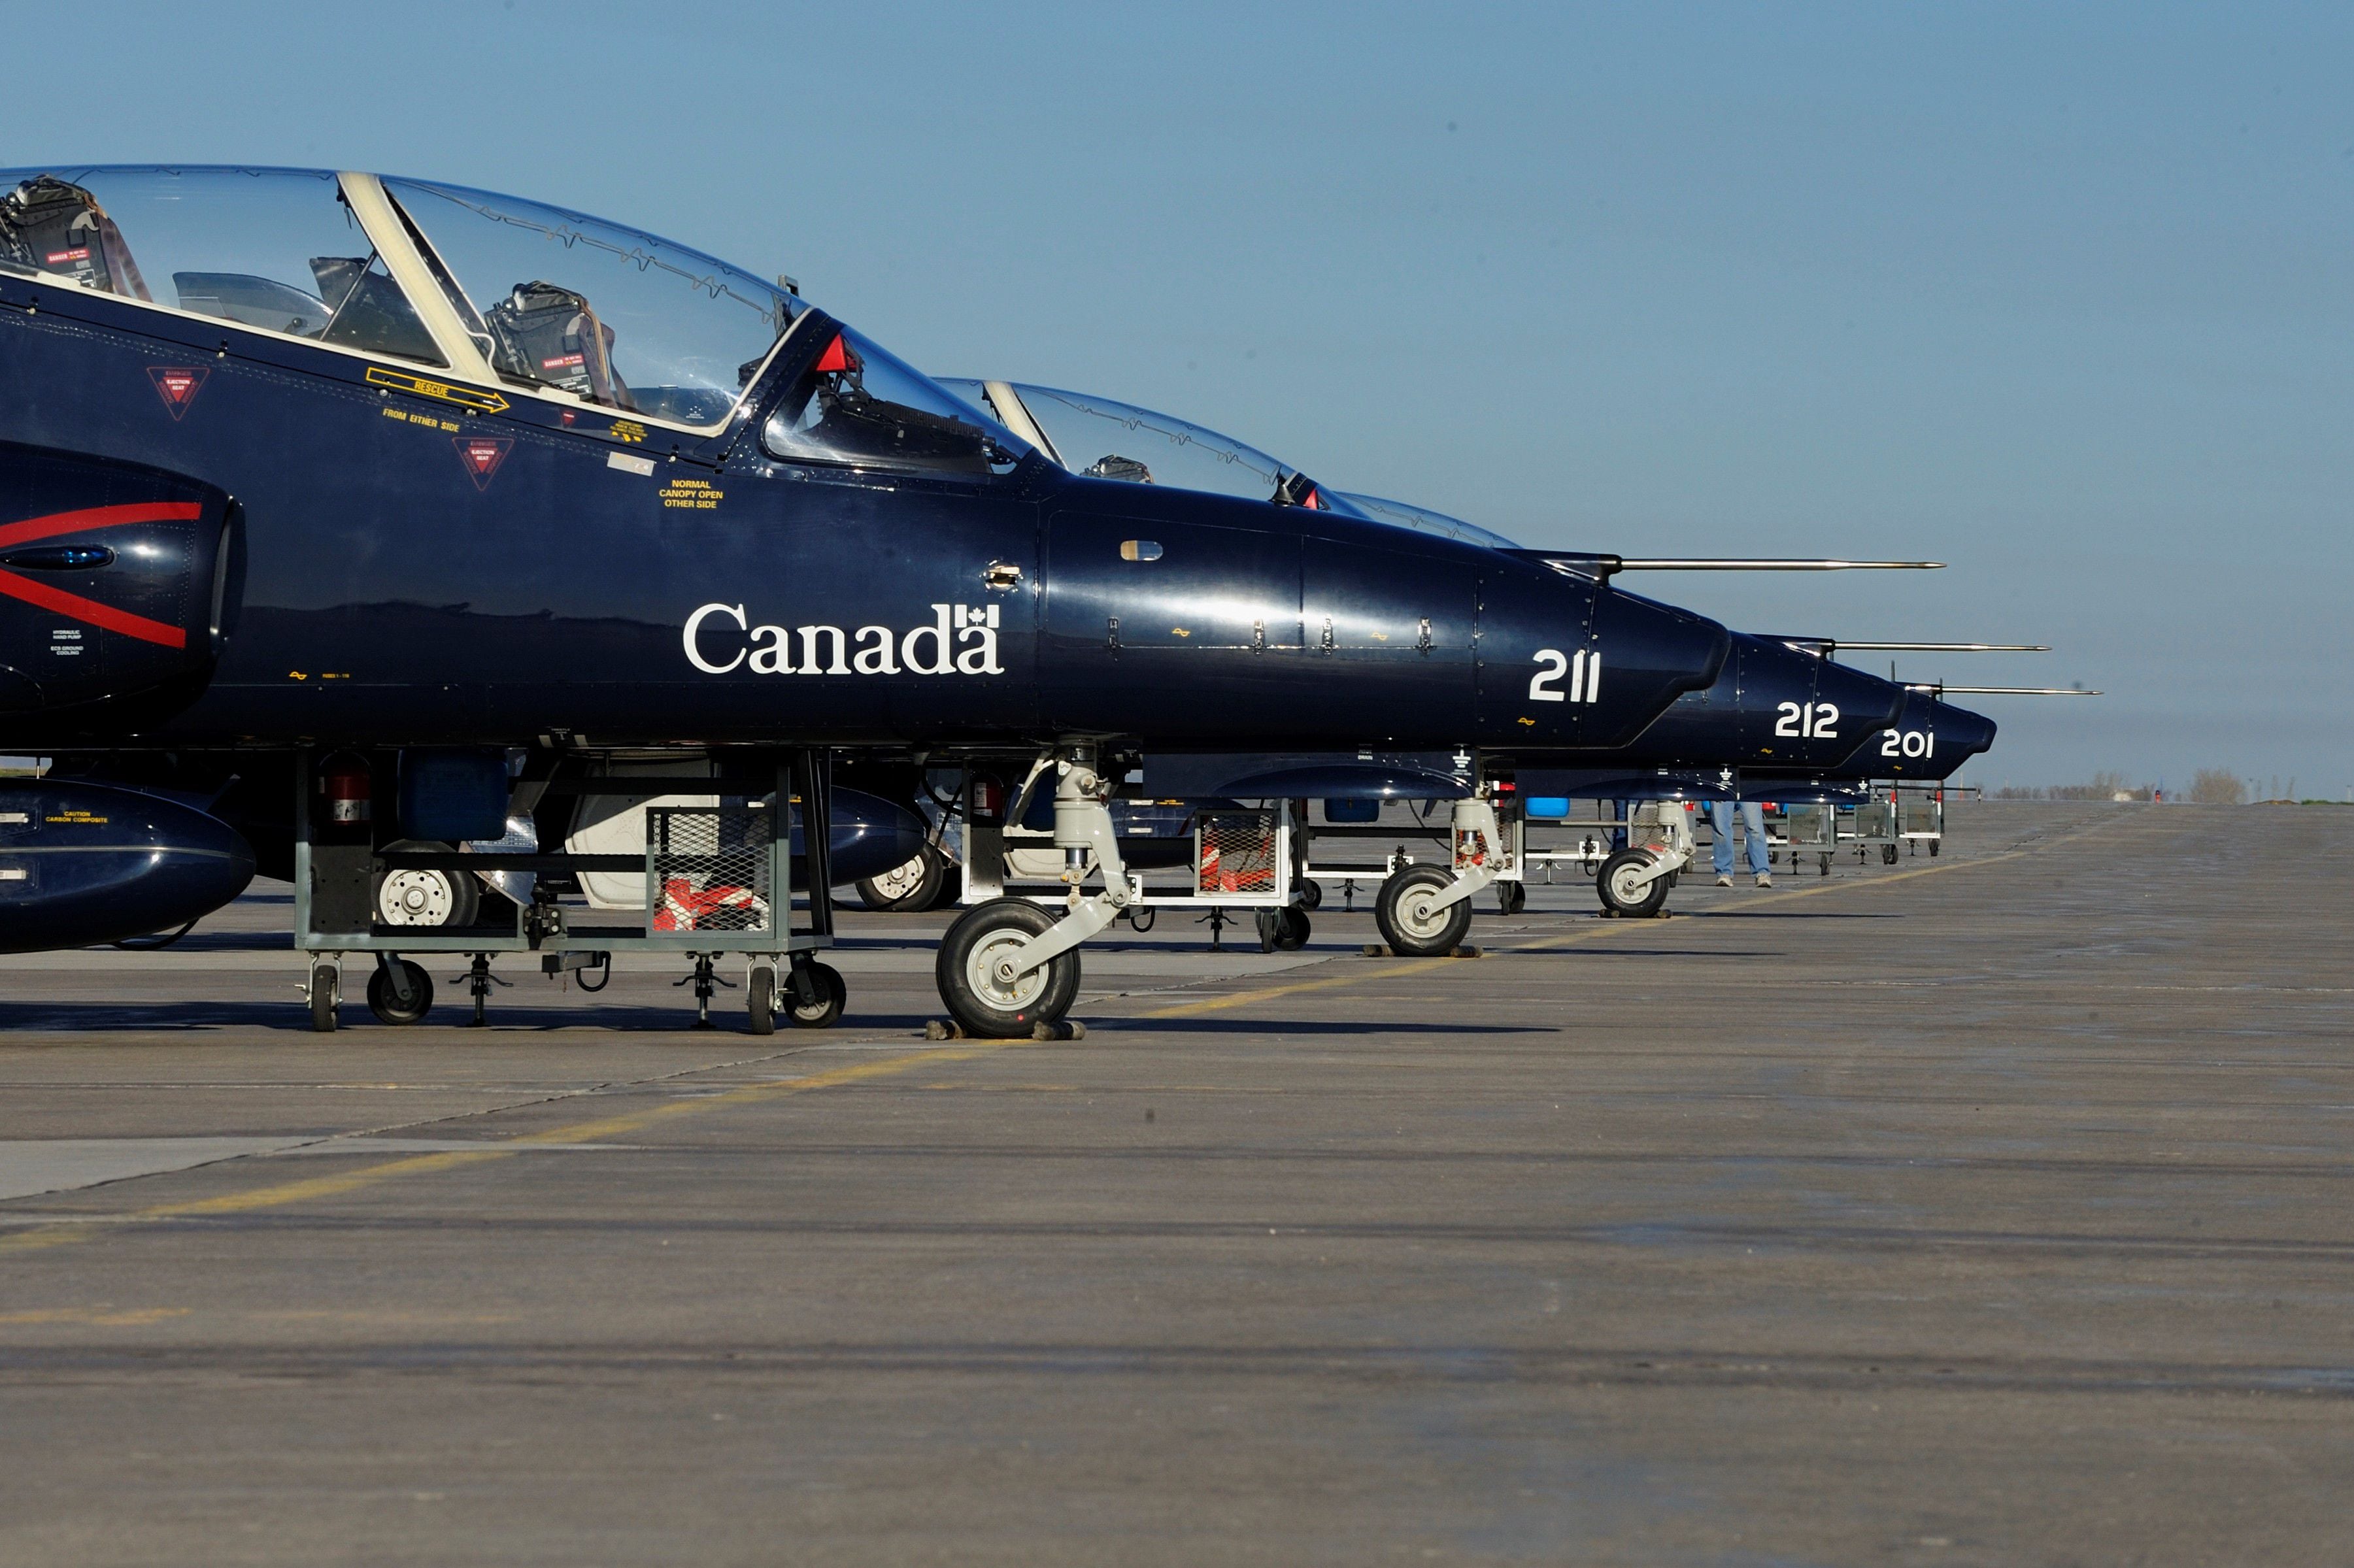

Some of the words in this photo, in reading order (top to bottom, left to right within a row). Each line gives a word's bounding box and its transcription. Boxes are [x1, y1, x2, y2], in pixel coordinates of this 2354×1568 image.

[414, 381, 450, 397] RESCUE
[383, 408, 407, 420] FROM
[409, 414, 438, 427] EITHER
[441, 422, 460, 433] SIDE
[659, 489, 697, 498] CANOPY
[698, 490, 723, 499] OPEN
[672, 480, 711, 489] NORMAL
[664, 499, 694, 508] OTHER
[683, 603, 1005, 675] Canada
[1529, 648, 1600, 703] 211
[1775, 701, 1839, 739] 212
[1881, 729, 1934, 759] 201
